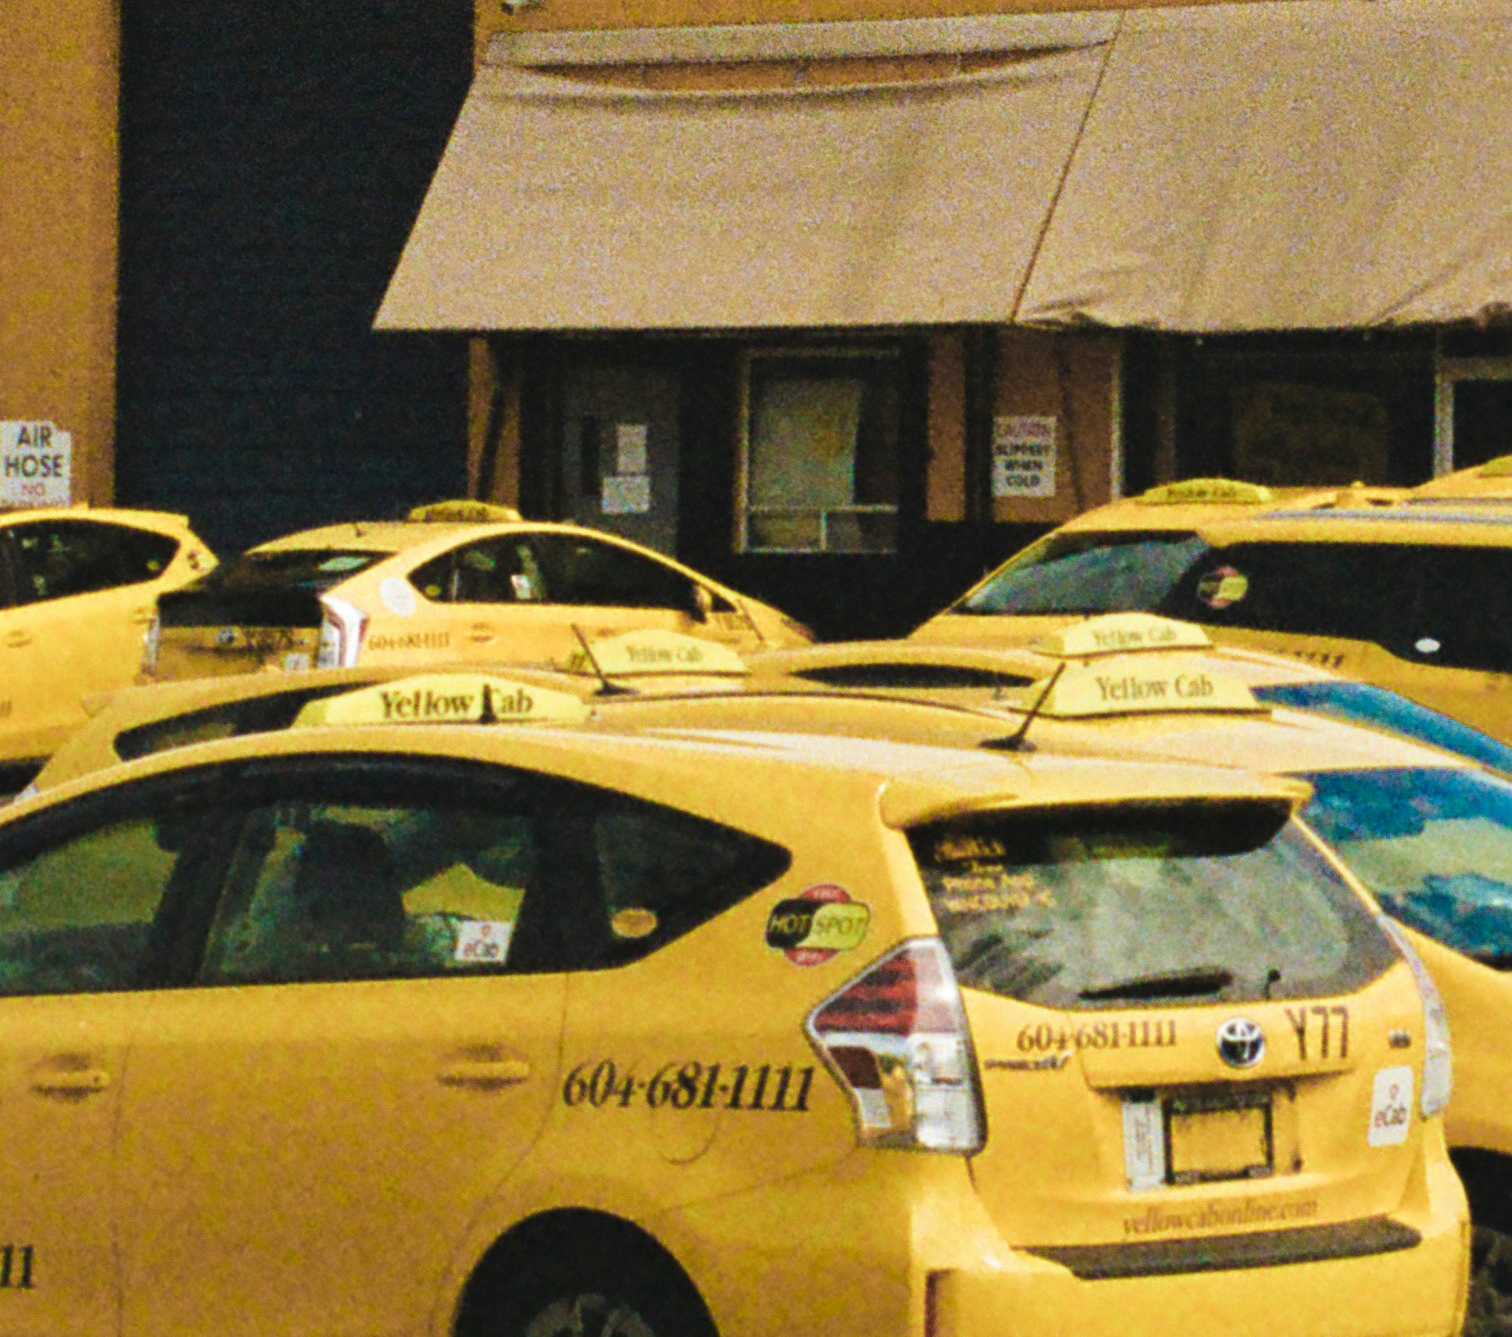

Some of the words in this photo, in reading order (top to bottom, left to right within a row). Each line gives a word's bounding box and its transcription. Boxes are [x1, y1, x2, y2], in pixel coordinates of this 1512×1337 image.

[17, 425, 52, 447] AIR
[3, 454, 65, 477] HOSE
[1092, 629, 1144, 647] Yellow
[1147, 626, 1177, 642] Cab
[626, 645, 674, 663] Yellow
[676, 645, 703, 662] Cab
[1094, 676, 1166, 701] Yellow
[1174, 674, 1215, 699] Cab
[380, 690, 473, 719] Yellow
[770, 913, 813, 935] HOT
[813, 915, 868, 937] SPOT
[1285, 1005, 1350, 1061] Y77
[1374, 1103, 1407, 1128] eCab
[1122, 1199, 1320, 1237] yellowcabonline.com
